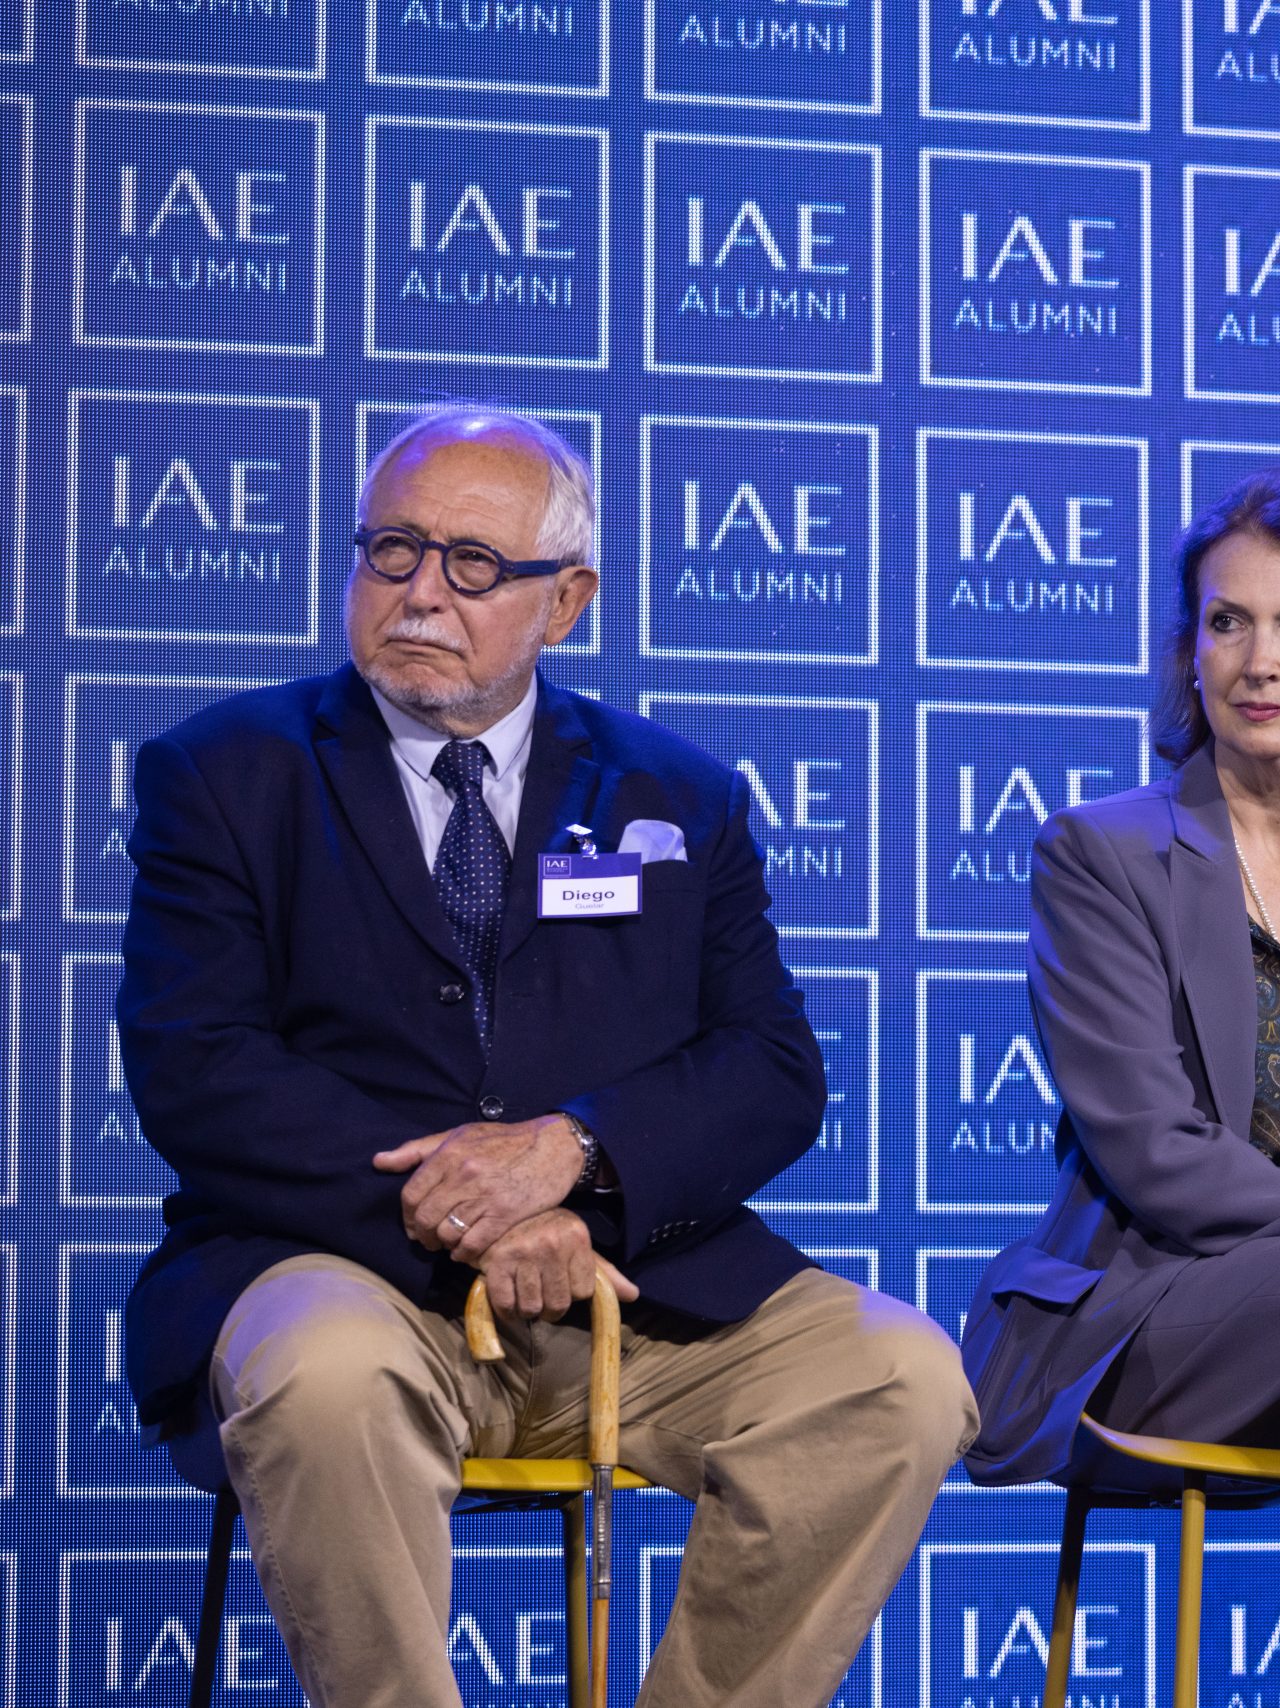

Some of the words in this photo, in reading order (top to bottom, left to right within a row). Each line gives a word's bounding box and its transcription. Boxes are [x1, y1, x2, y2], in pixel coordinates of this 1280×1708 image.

[402, 0, 573, 35] ALUMNI
[680, 15, 846, 52] ALUMNI
[954, 33, 1115, 69] ALUMNI
[121, 167, 289, 243] IAE
[410, 182, 574, 258] IAE
[688, 198, 847, 273] IAE
[963, 213, 1117, 287] IAE
[112, 254, 286, 292] ALUMNI
[401, 269, 572, 306] ALUMNI
[680, 284, 846, 320] ALUMNI
[955, 299, 1116, 334] ALUMNI
[114, 456, 283, 532] IAE
[684, 481, 844, 555] IAE
[960, 493, 1115, 565] IAE
[104, 546, 280, 581] ALUMNI
[675, 568, 842, 602] ALUMNI
[951, 579, 1113, 612] ALUMNI
[546, 860, 568, 868] IAE
[767, 846, 842, 876] MNI
[951, 850, 1030, 882] ALU
[562, 890, 615, 902] Diego
[960, 1035, 1056, 1103] IA
[952, 1121, 1053, 1153] ALU
[106, 1616, 277, 1690] IAE
[446, 1612, 566, 1684] AE
[964, 1607, 1121, 1678] IAE
